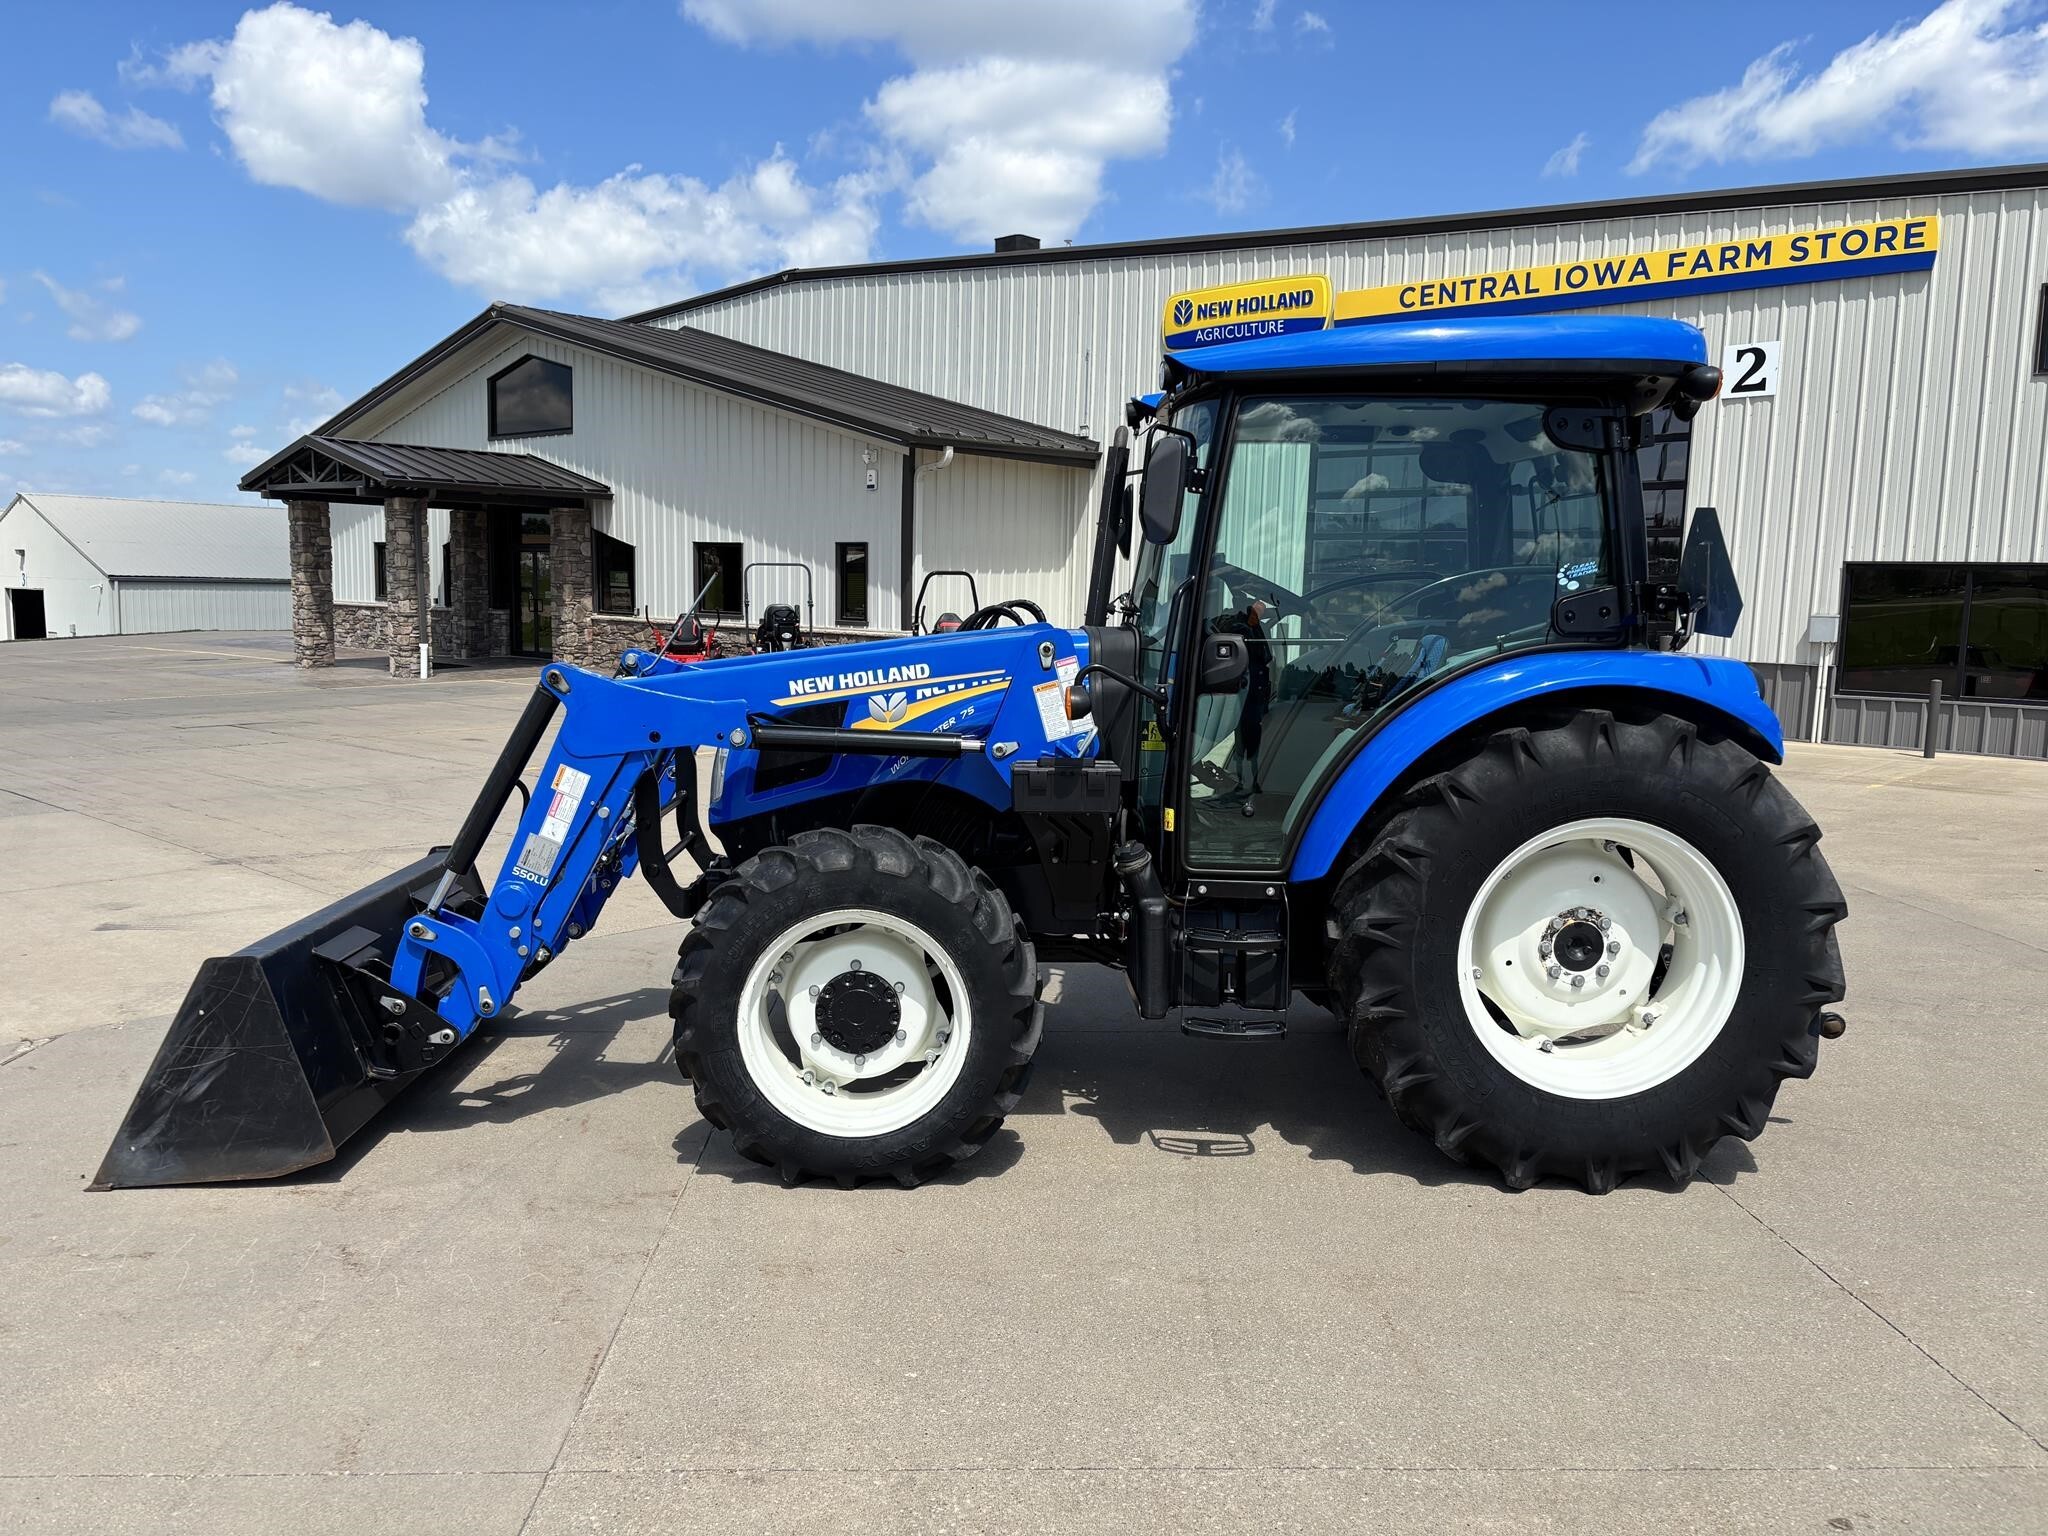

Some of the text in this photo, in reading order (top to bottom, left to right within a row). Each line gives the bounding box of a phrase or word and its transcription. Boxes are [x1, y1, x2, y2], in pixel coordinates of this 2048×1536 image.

[1399, 221, 1927, 309] CENTRAL IOWA FARM STORE
[1197, 289, 1314, 321] NEW HOLLAND
[1195, 320, 1285, 343] AGRICULTURE
[1730, 346, 1768, 394] 2
[788, 676, 834, 696] NEW
[839, 663, 931, 689] HOLLAND
[960, 705, 976, 720] 75
[512, 866, 549, 887] 550LU
